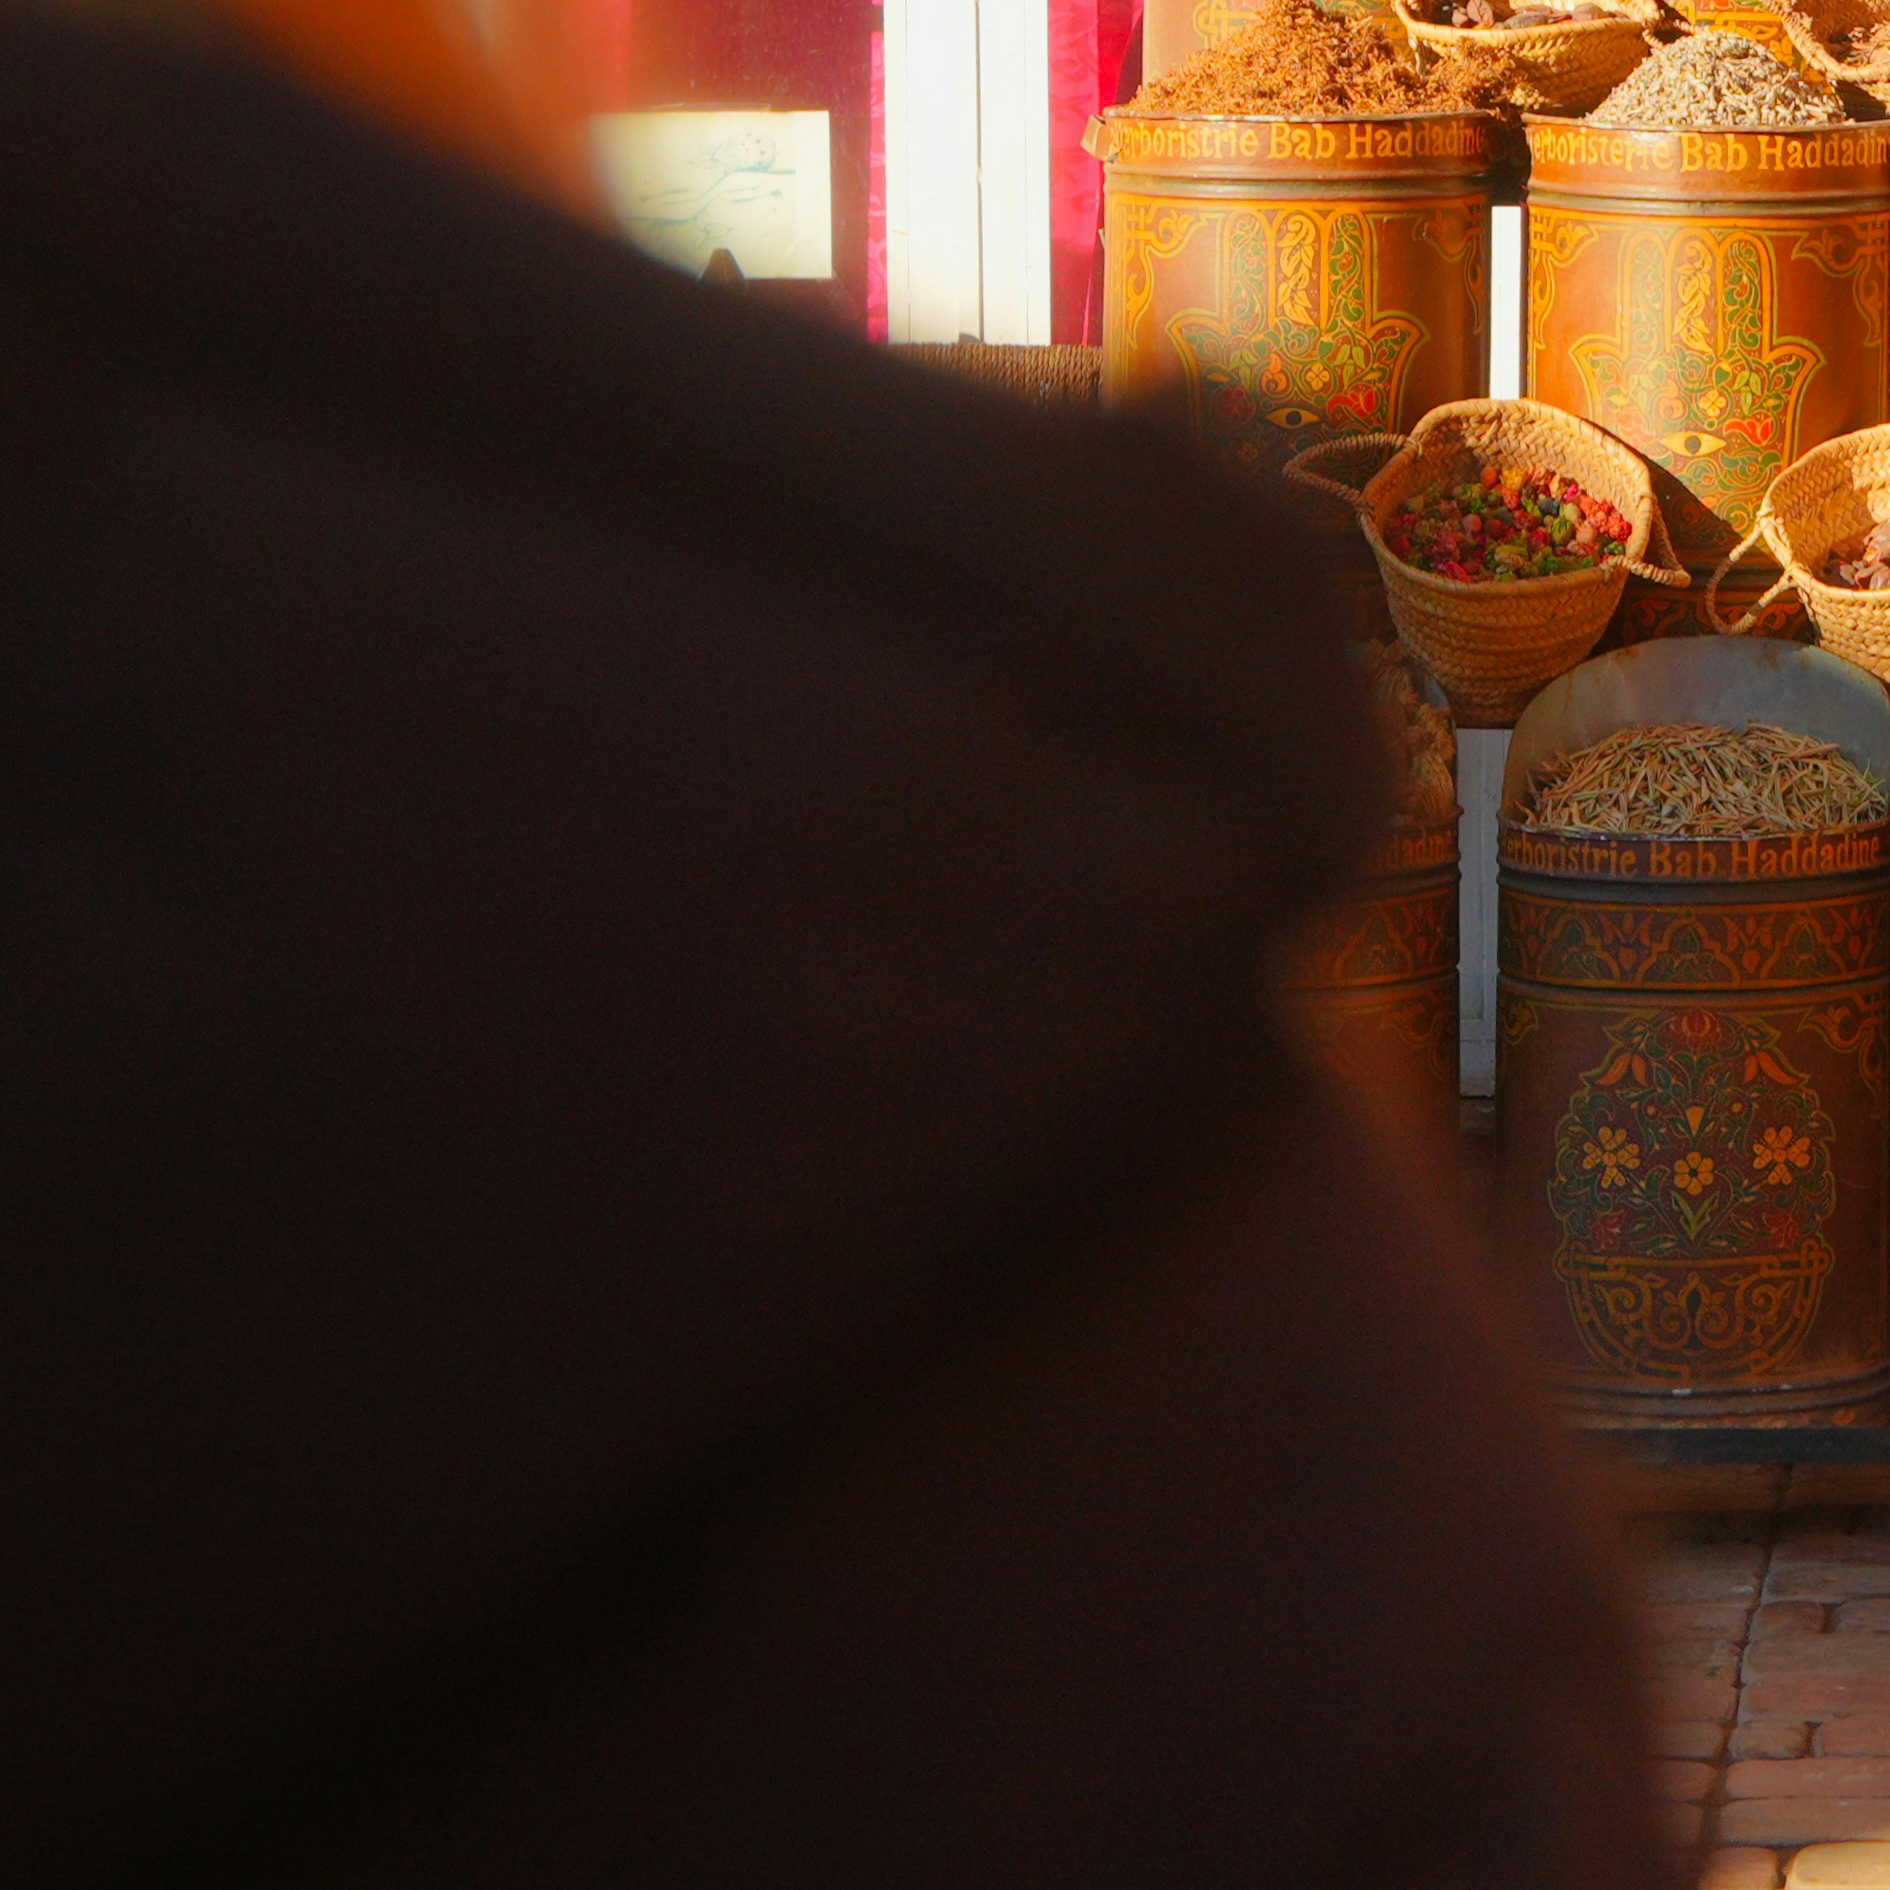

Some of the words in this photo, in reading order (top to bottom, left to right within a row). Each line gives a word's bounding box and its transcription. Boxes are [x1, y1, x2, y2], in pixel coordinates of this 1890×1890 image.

[1266, 120, 1335, 160] Bab
[1680, 132, 1748, 173] Bab
[1648, 839, 1718, 880] Bab
[1729, 830, 1880, 882] Haddadine
